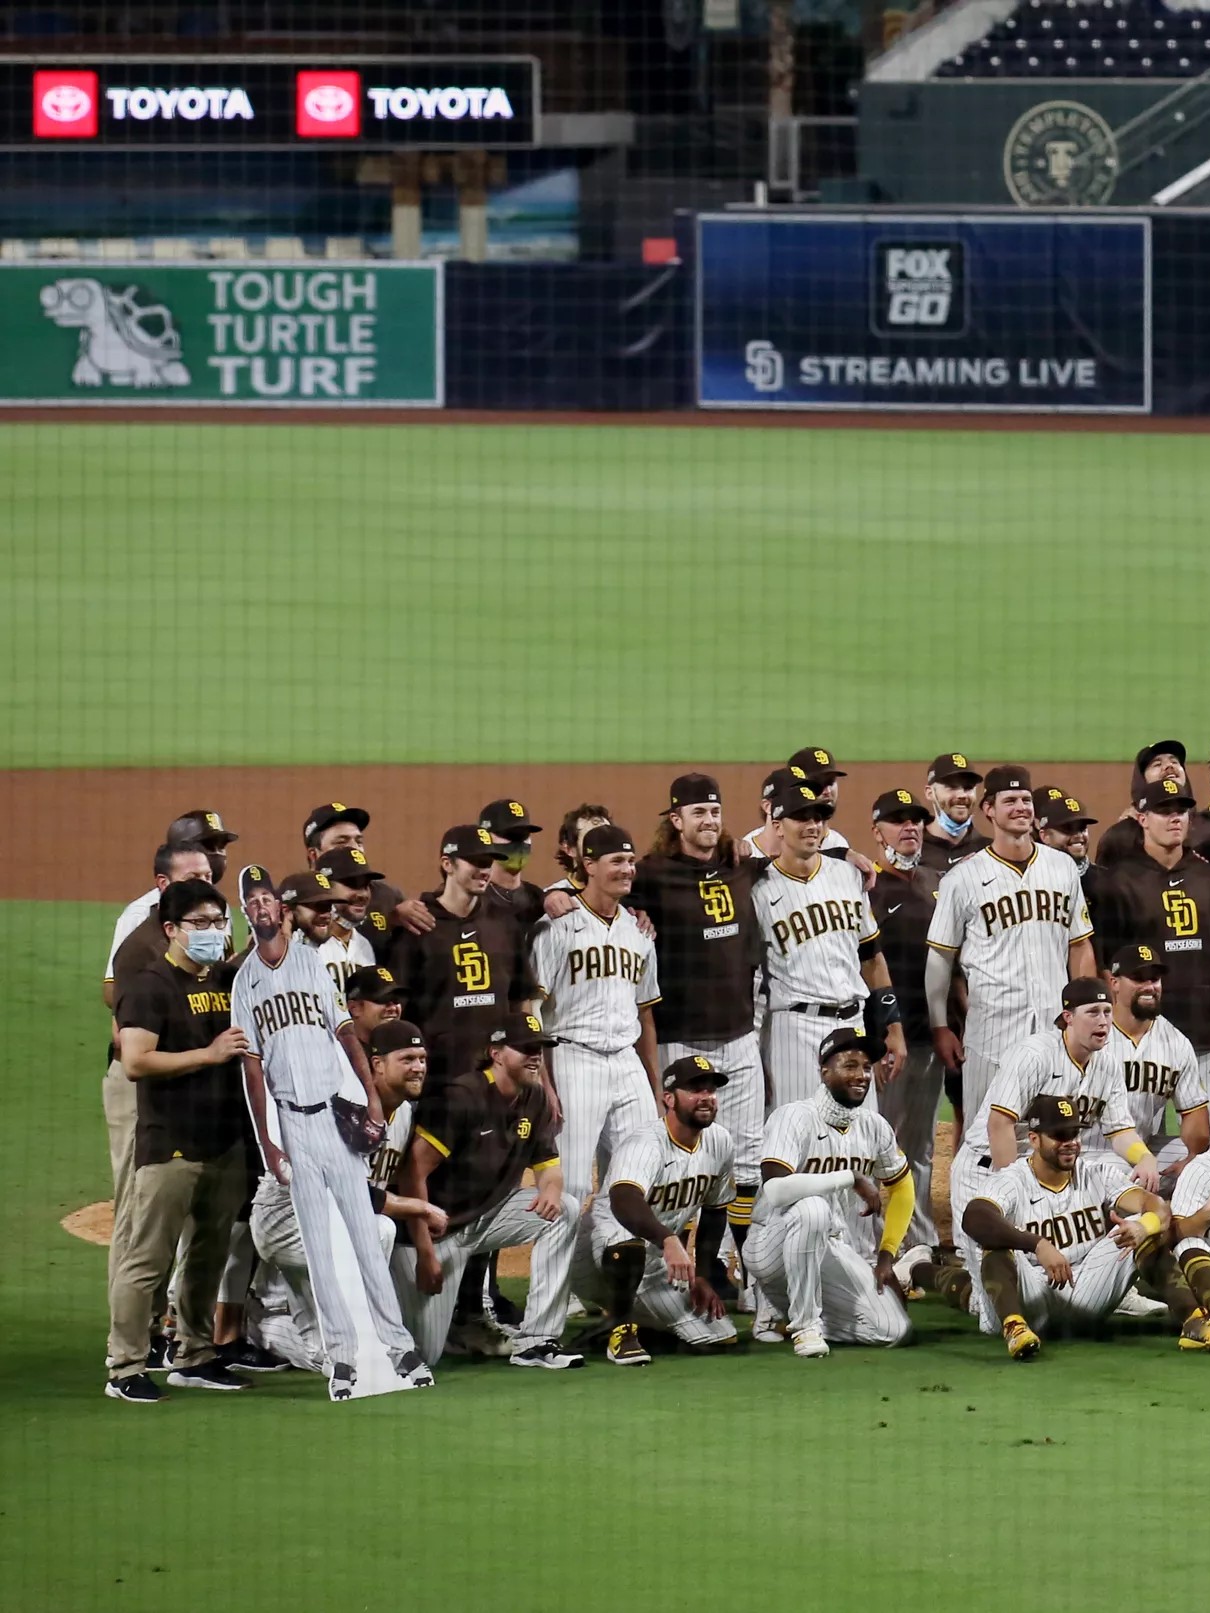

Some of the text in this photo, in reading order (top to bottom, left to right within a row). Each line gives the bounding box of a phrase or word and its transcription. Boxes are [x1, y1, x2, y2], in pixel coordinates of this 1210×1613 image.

[107, 87, 254, 120] TOYOTA
[368, 87, 514, 119] TOYOTA
[887, 248, 951, 278] FOX
[208, 272, 376, 311] TOUGH
[888, 294, 951, 325] GO
[208, 314, 377, 353] TURTLE
[208, 358, 377, 395] TURF
[745, 340, 1096, 392] SD STREAMING LIVE
[814, 750, 829, 765] SD
[952, 754, 967, 769] SD
[897, 791, 912, 803] SD
[1163, 780, 1178, 793] SD
[509, 802, 524, 817] SD
[1065, 798, 1081, 812] SD
[477, 829, 492, 844] SD
[351, 850, 368, 864] SD
[316, 872, 330, 889] SD
[699, 880, 734, 923] SD
[980, 889, 1072, 937] PADRES
[1162, 890, 1198, 936] SD
[370, 912, 386, 930] SD
[771, 900, 863, 955] PADRES
[1139, 946, 1152, 960] SD
[453, 942, 490, 991] SD
[252, 991, 326, 1045] PADRES
[526, 1015, 541, 1031] SD
[694, 1056, 710, 1070] SD
[1058, 1101, 1073, 1116] SD
[518, 1118, 531, 1138] SD
[1026, 1205, 1105, 1250] PADRE
